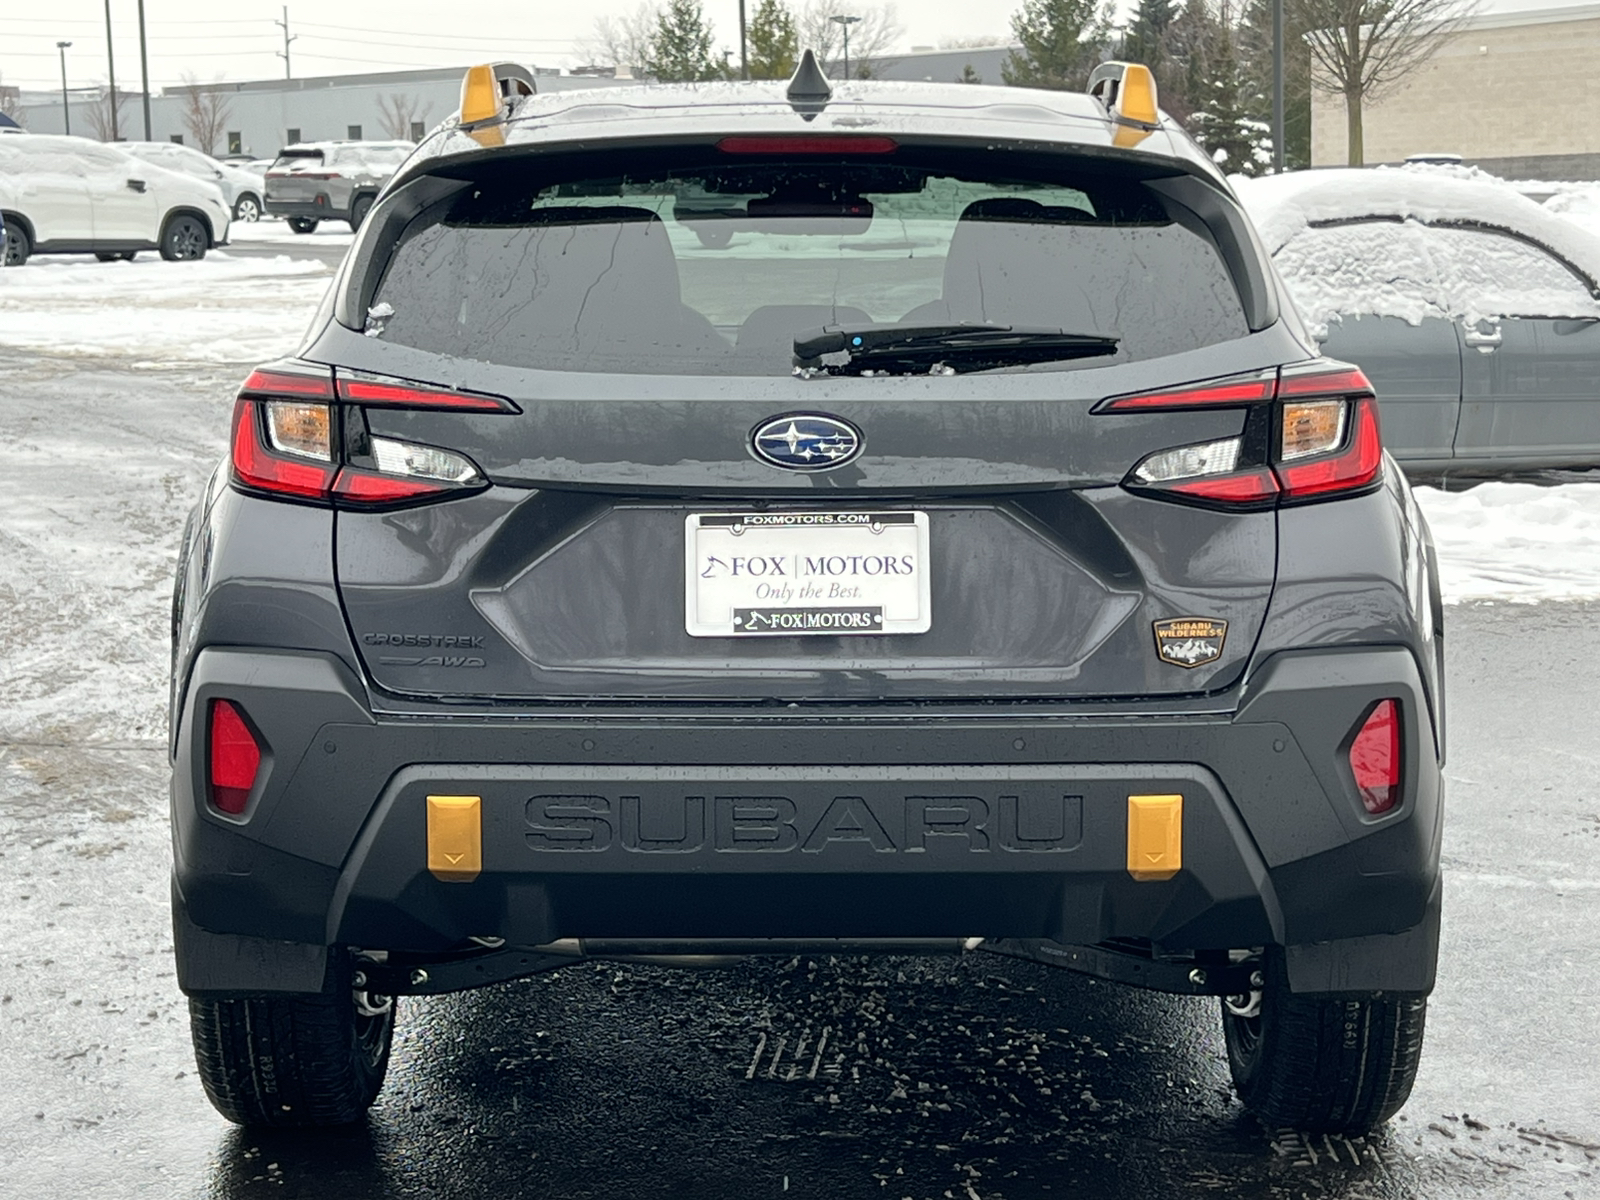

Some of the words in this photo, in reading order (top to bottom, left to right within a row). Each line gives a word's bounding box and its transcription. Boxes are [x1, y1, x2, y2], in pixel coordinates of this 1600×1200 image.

[743, 514, 870, 525] FOXMOTORS.COM
[731, 556, 786, 576] FOX
[804, 555, 914, 576] MOTORS
[756, 582, 795, 604] Only
[799, 581, 823, 599] the
[828, 582, 863, 599] Best.
[1158, 628, 1223, 637] WILDERNESS
[1170, 622, 1212, 630] SUBARU
[362, 633, 485, 649] CROSSTREK
[418, 656, 487, 668] AWD
[524, 794, 1084, 853] SUBARU
